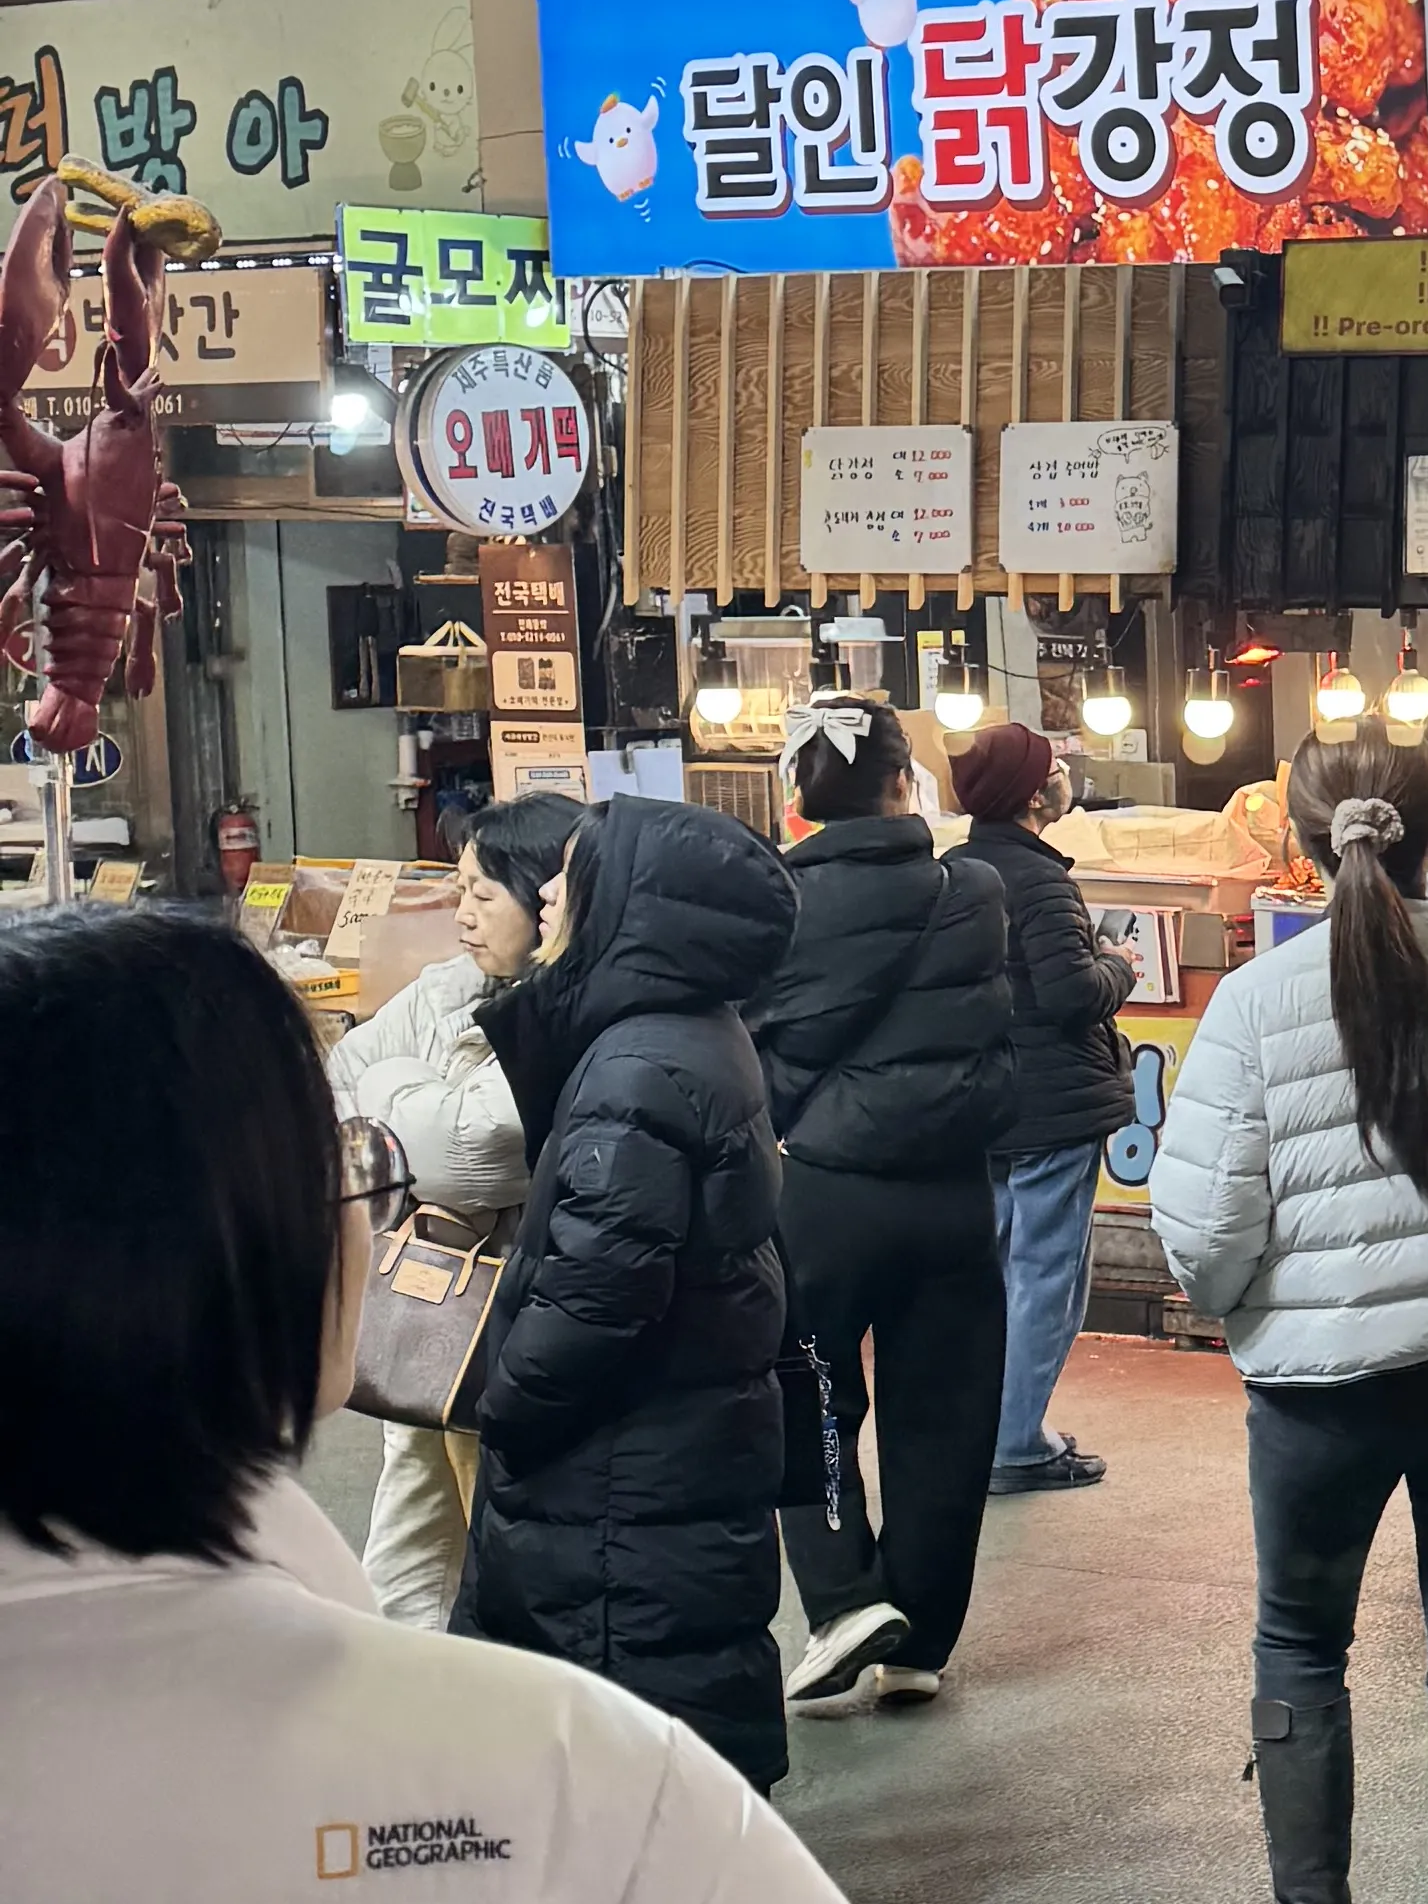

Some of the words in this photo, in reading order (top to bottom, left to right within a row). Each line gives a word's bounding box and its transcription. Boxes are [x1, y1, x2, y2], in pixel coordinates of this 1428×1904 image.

[687, 54, 878, 201] 달인
[347, 229, 566, 325] 귤모찌
[446, 406, 582, 480] 오메기떡
[366, 1839, 511, 1870] GEOGRAPHIC
[368, 1817, 482, 1846] NATIONAL
